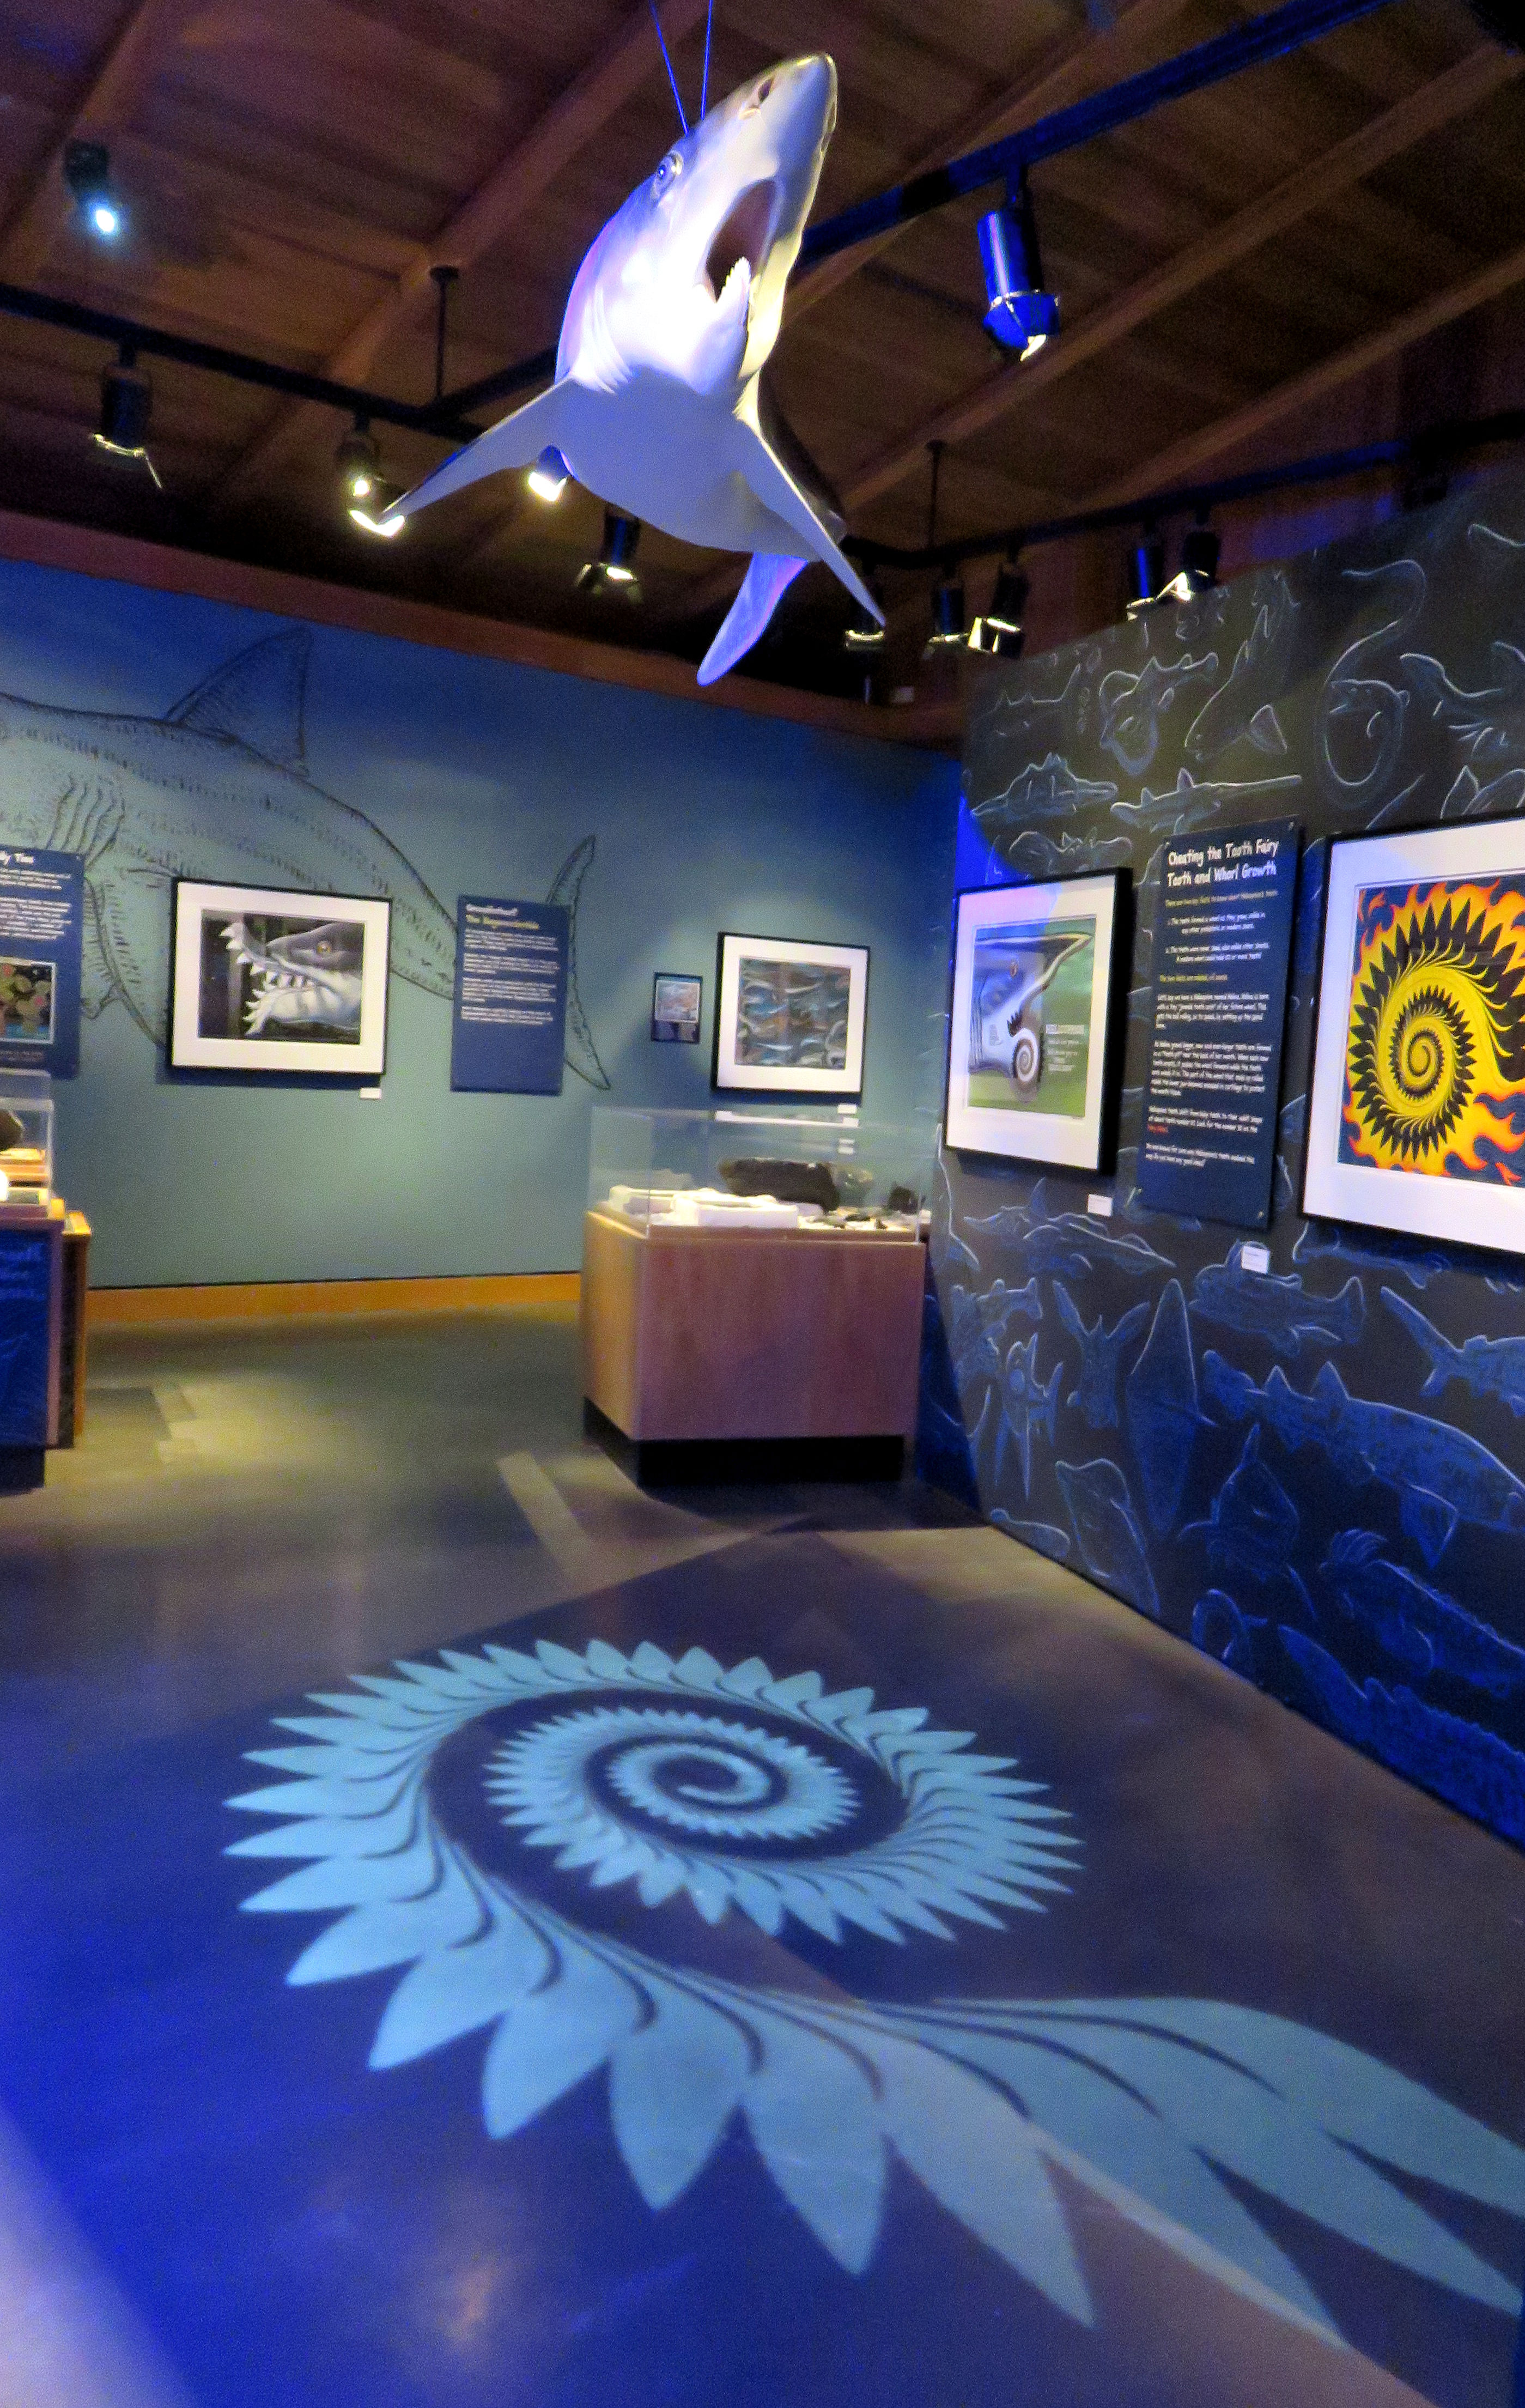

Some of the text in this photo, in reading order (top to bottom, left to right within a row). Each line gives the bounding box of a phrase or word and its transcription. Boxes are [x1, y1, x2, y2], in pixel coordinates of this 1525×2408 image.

[1207, 846, 1222, 860] the
[1225, 840, 1253, 858] Tooth
[1255, 838, 1279, 857] Fairy
[1168, 860, 1277, 887] Tooth and Whorl Growth
